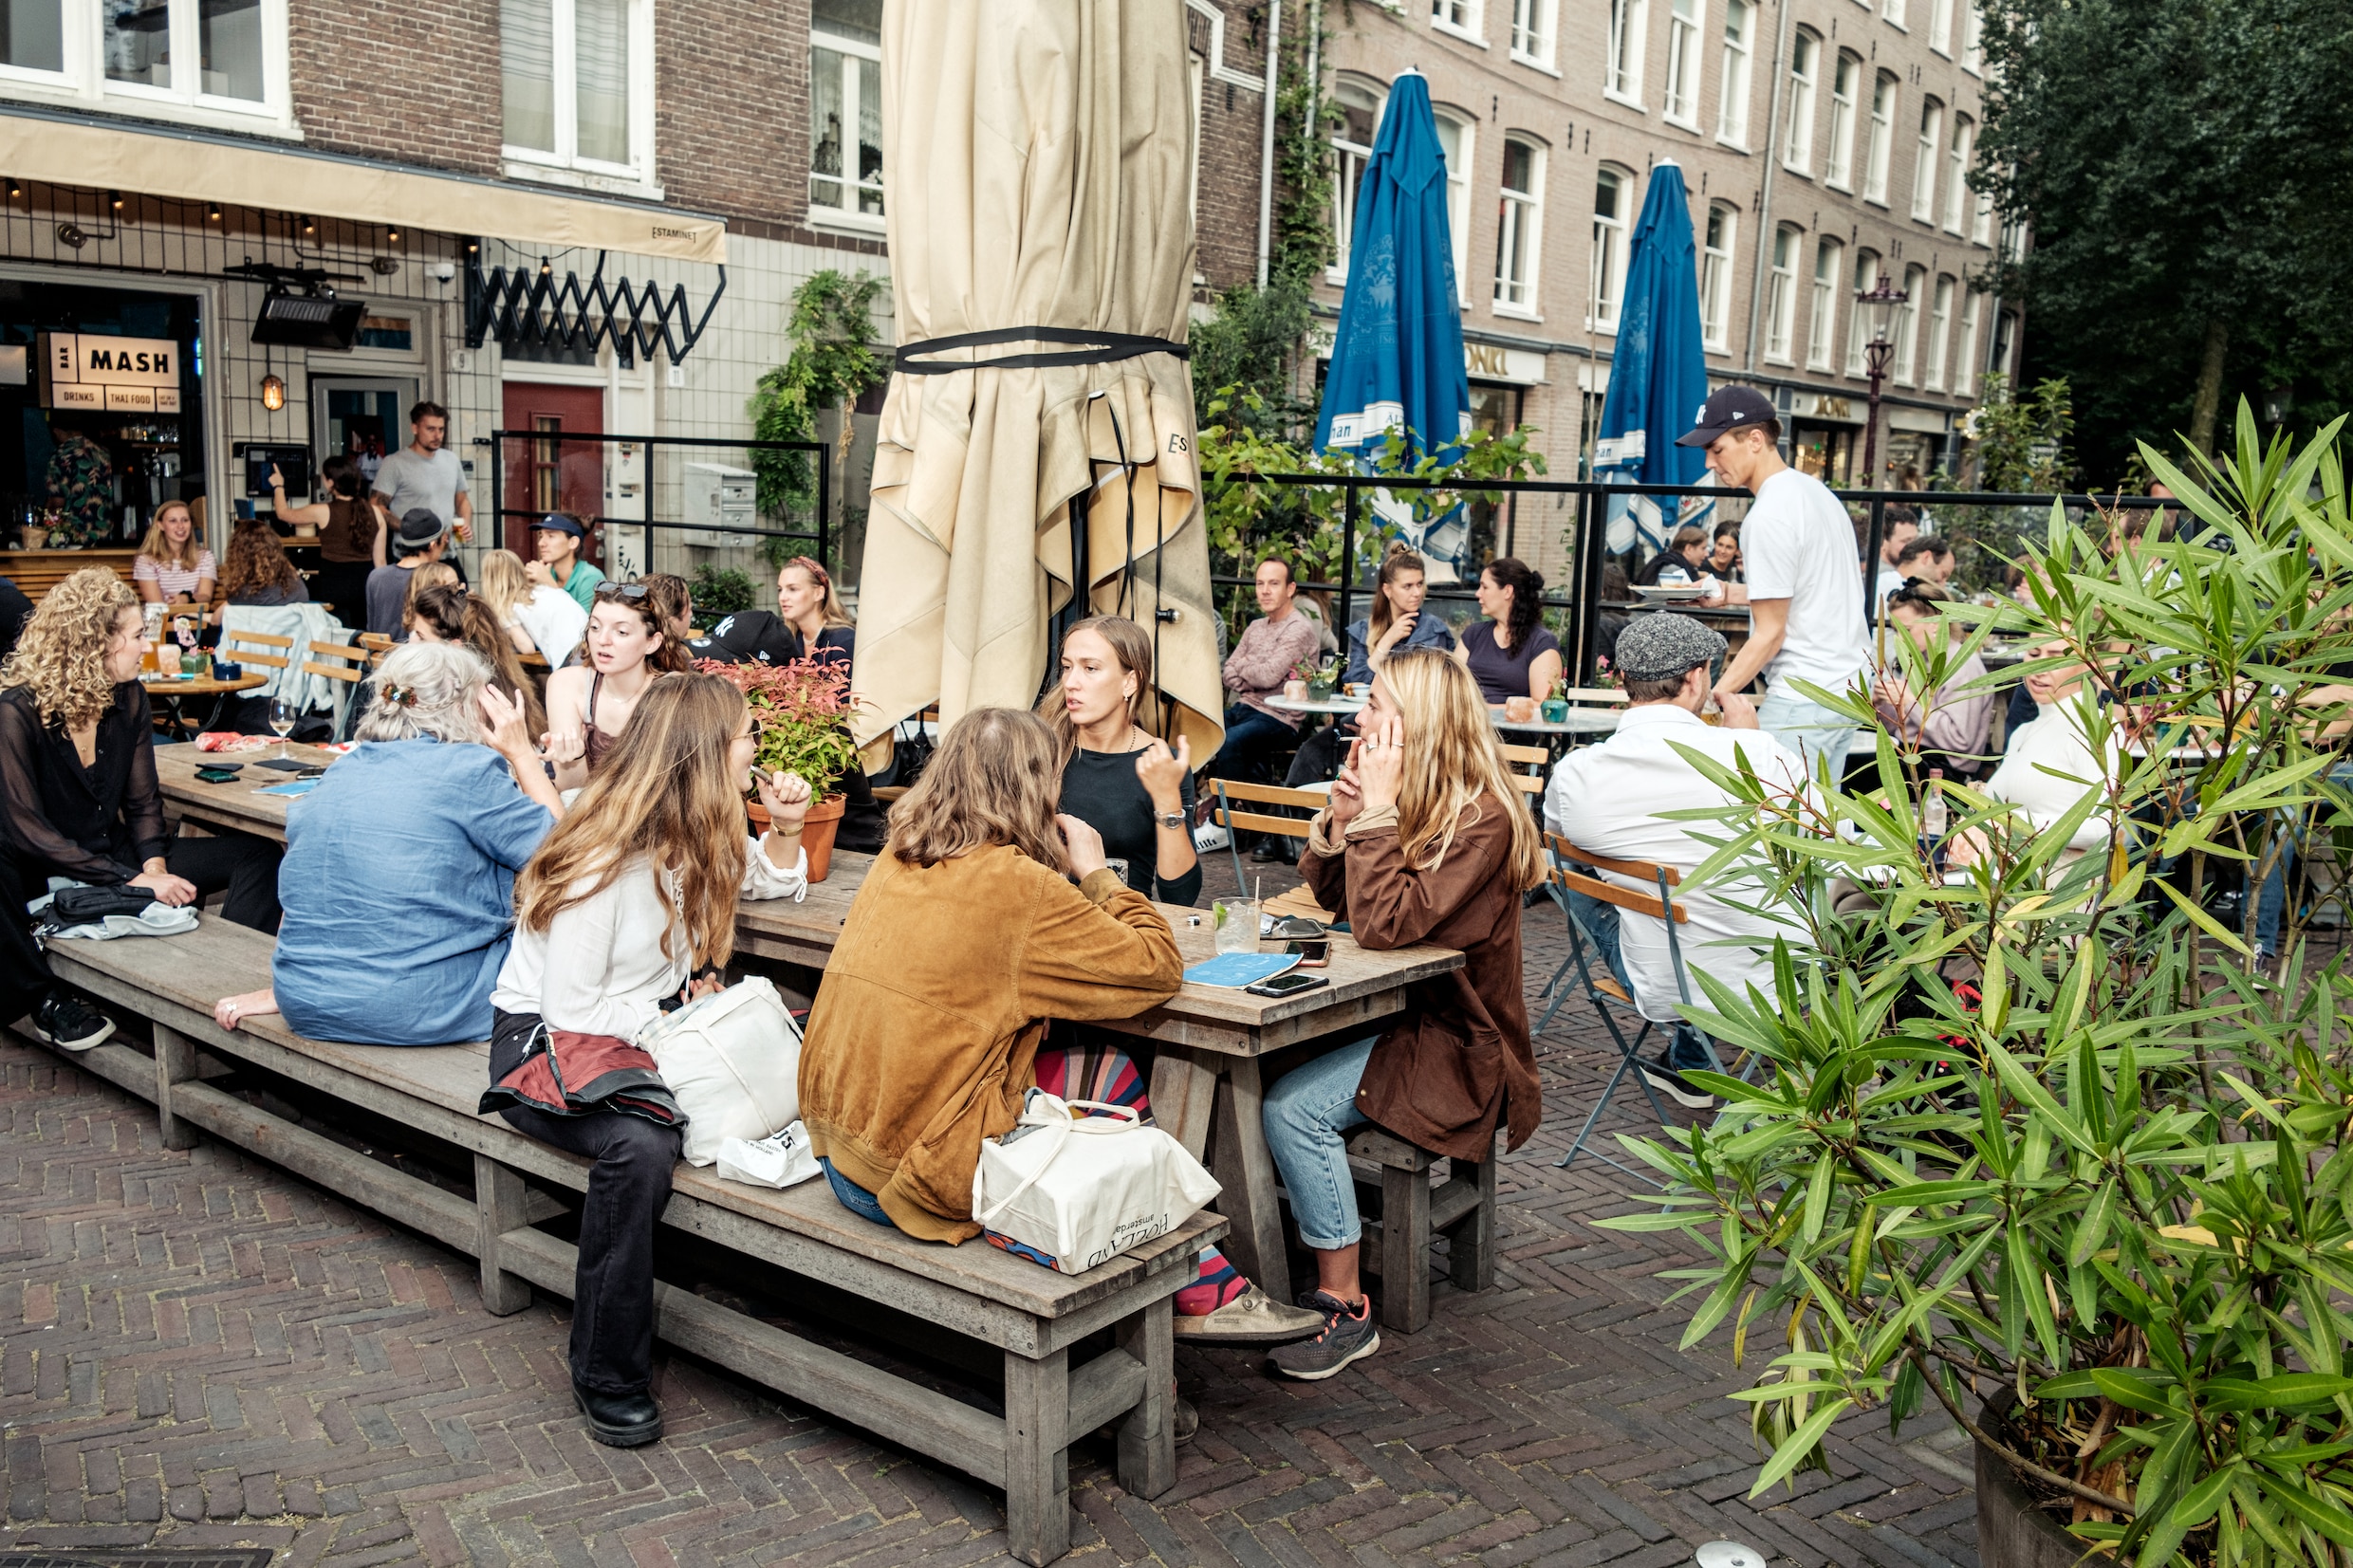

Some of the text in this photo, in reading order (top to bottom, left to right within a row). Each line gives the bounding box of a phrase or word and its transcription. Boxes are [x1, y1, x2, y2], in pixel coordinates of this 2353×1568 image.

[652, 227, 697, 243] ESTAMINET
[60, 346, 69, 368] BAR
[90, 349, 169, 374] MASH
[64, 391, 95, 402] DRINKS
[110, 393, 151, 405] THAI FOOD
[1115, 1213, 1155, 1234] amsterda
